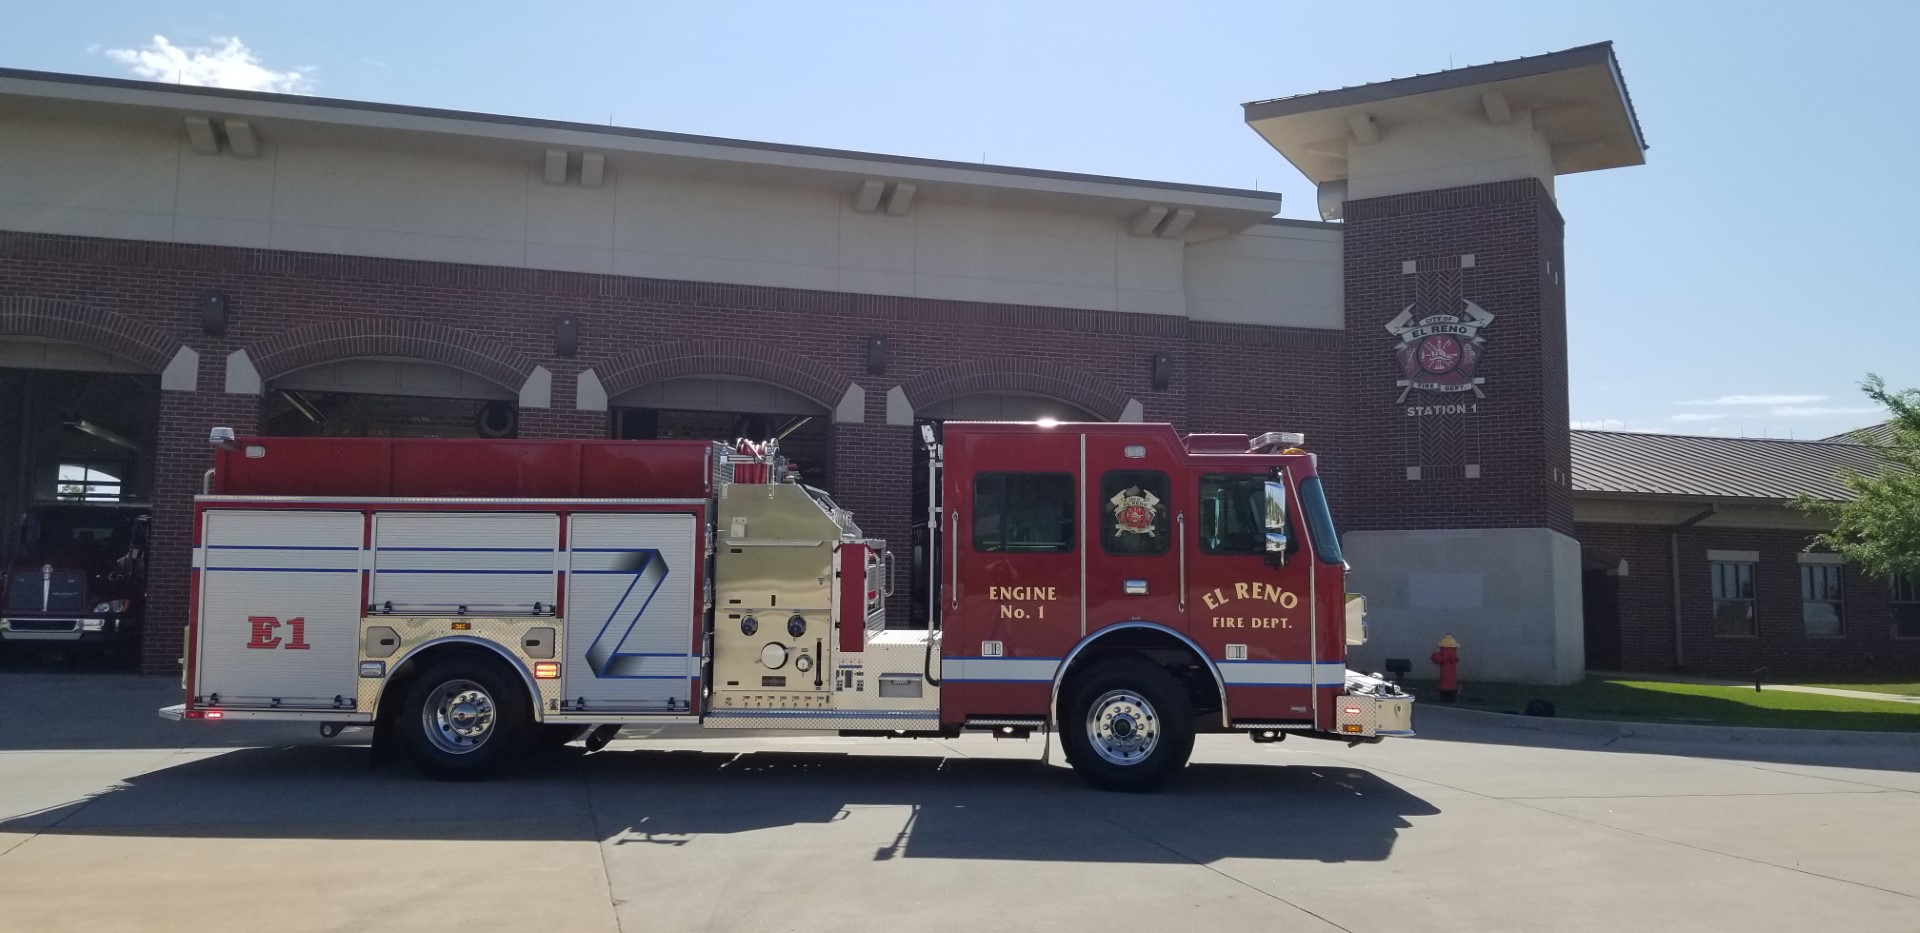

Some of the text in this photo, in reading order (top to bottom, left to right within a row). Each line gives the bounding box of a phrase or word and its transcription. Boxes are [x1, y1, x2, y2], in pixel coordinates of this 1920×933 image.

[1411, 325, 1467, 339] EL RENO
[1407, 403, 1477, 417] STATION 1
[989, 586, 1057, 600] ENGINE
[1202, 582, 1298, 610] EL RENO
[1000, 604, 1044, 619] No. 1
[1212, 616, 1292, 629] FIRE DEPT.
[246, 616, 311, 649] E1
